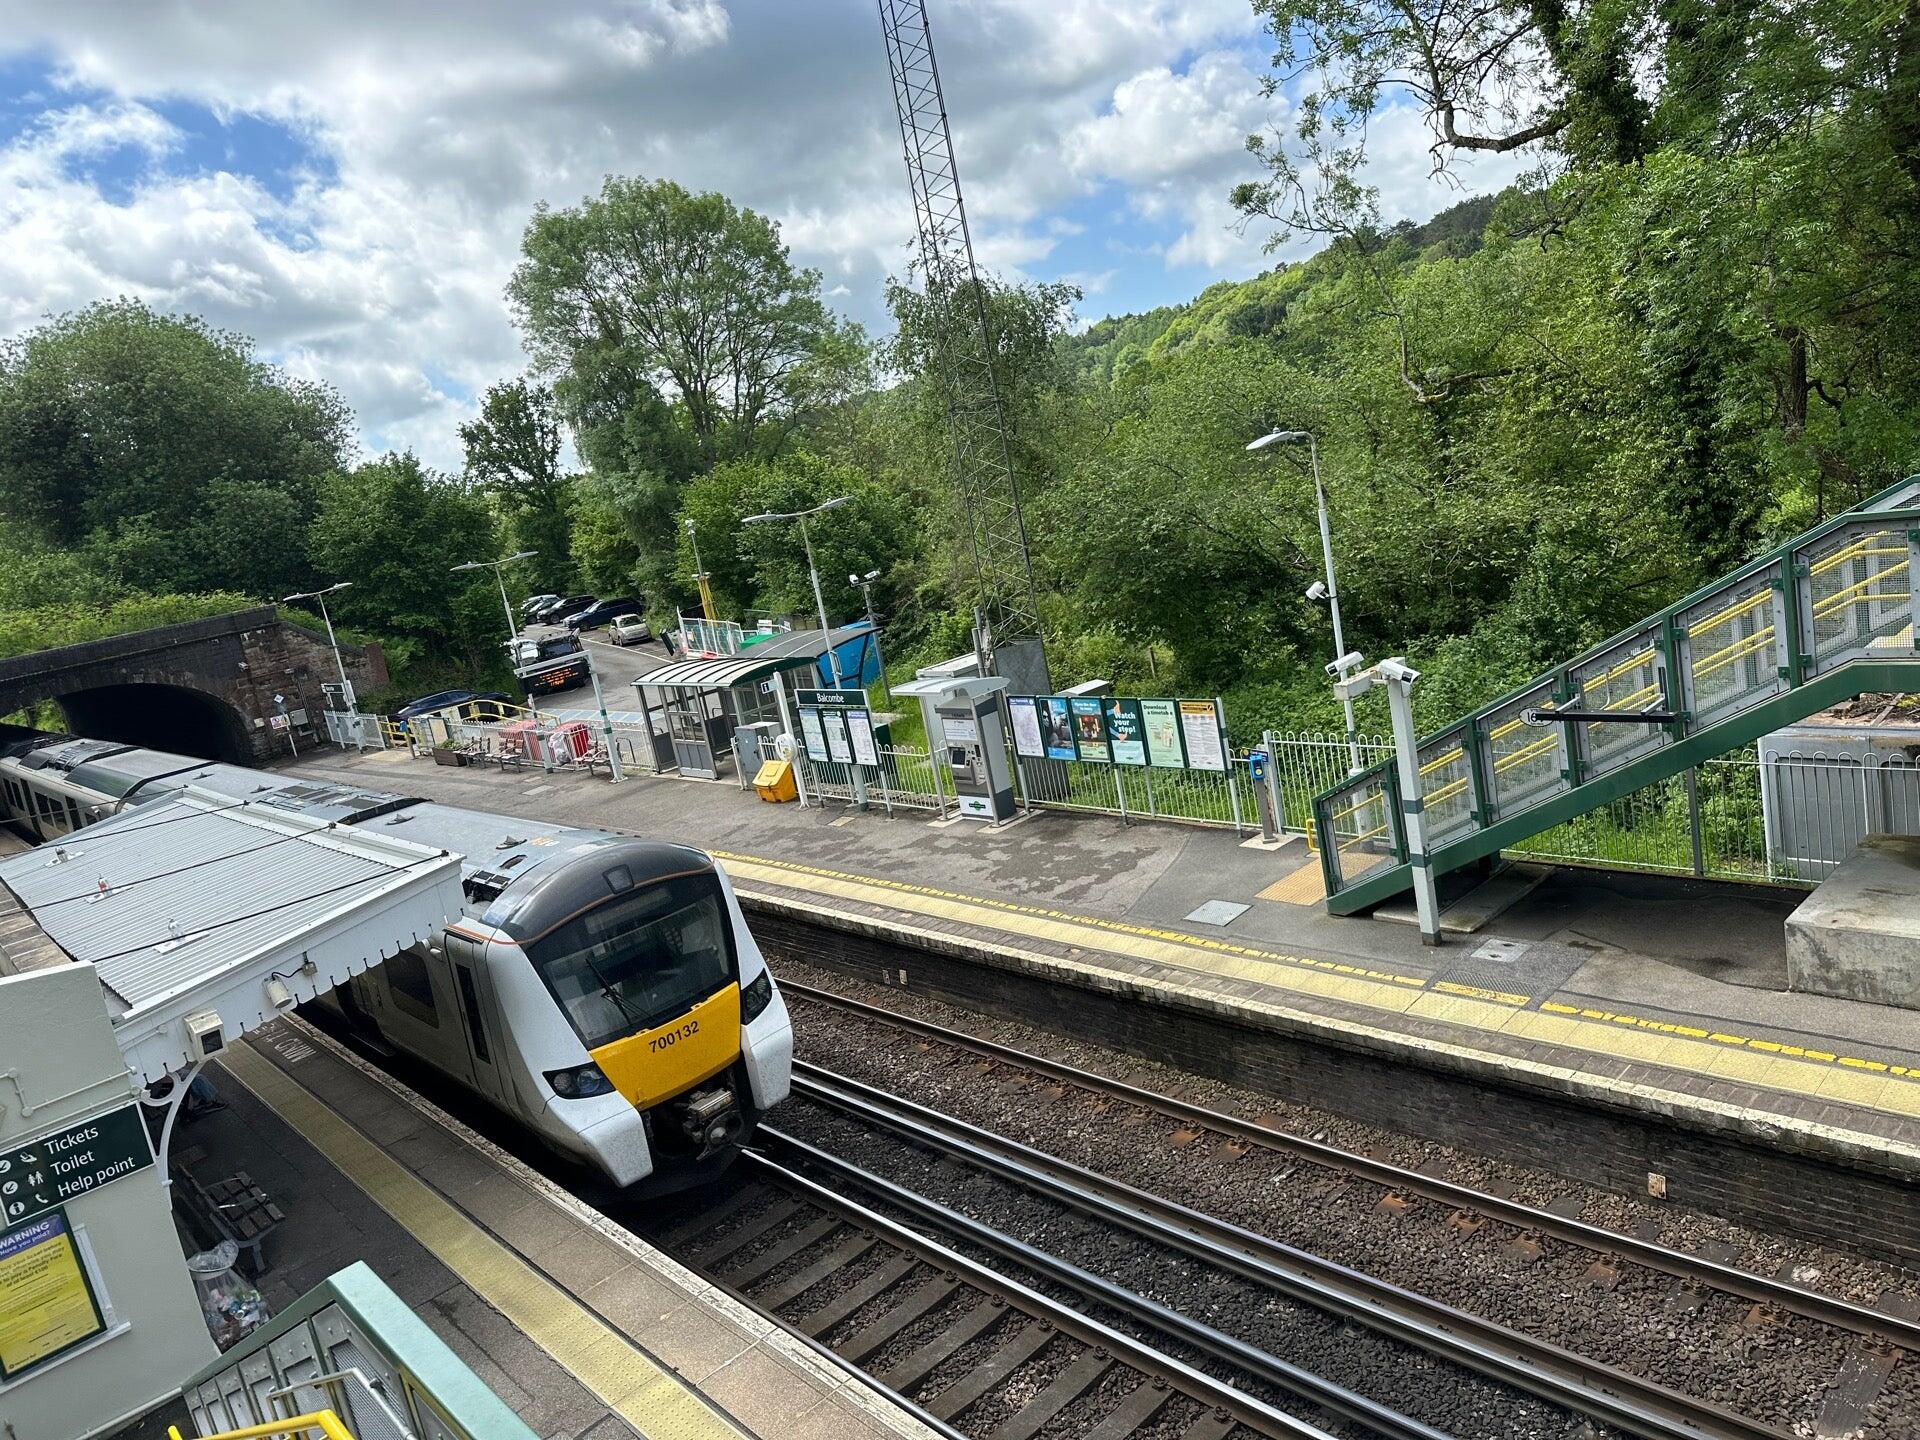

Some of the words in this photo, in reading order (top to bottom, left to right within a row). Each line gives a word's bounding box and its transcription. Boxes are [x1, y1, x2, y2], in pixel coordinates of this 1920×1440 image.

[817, 693, 844, 702] Balcombe
[1118, 726, 1136, 734] step!
[648, 1021, 699, 1053] 700132
[44, 1127, 99, 1155] Tickets
[50, 1150, 95, 1175] Toilet
[57, 1175, 93, 1197] Help
[96, 1156, 136, 1184] point
[0, 1221, 50, 1249] WARNING
[18, 1240, 31, 1248] you
[32, 1230, 50, 1242] paid?
